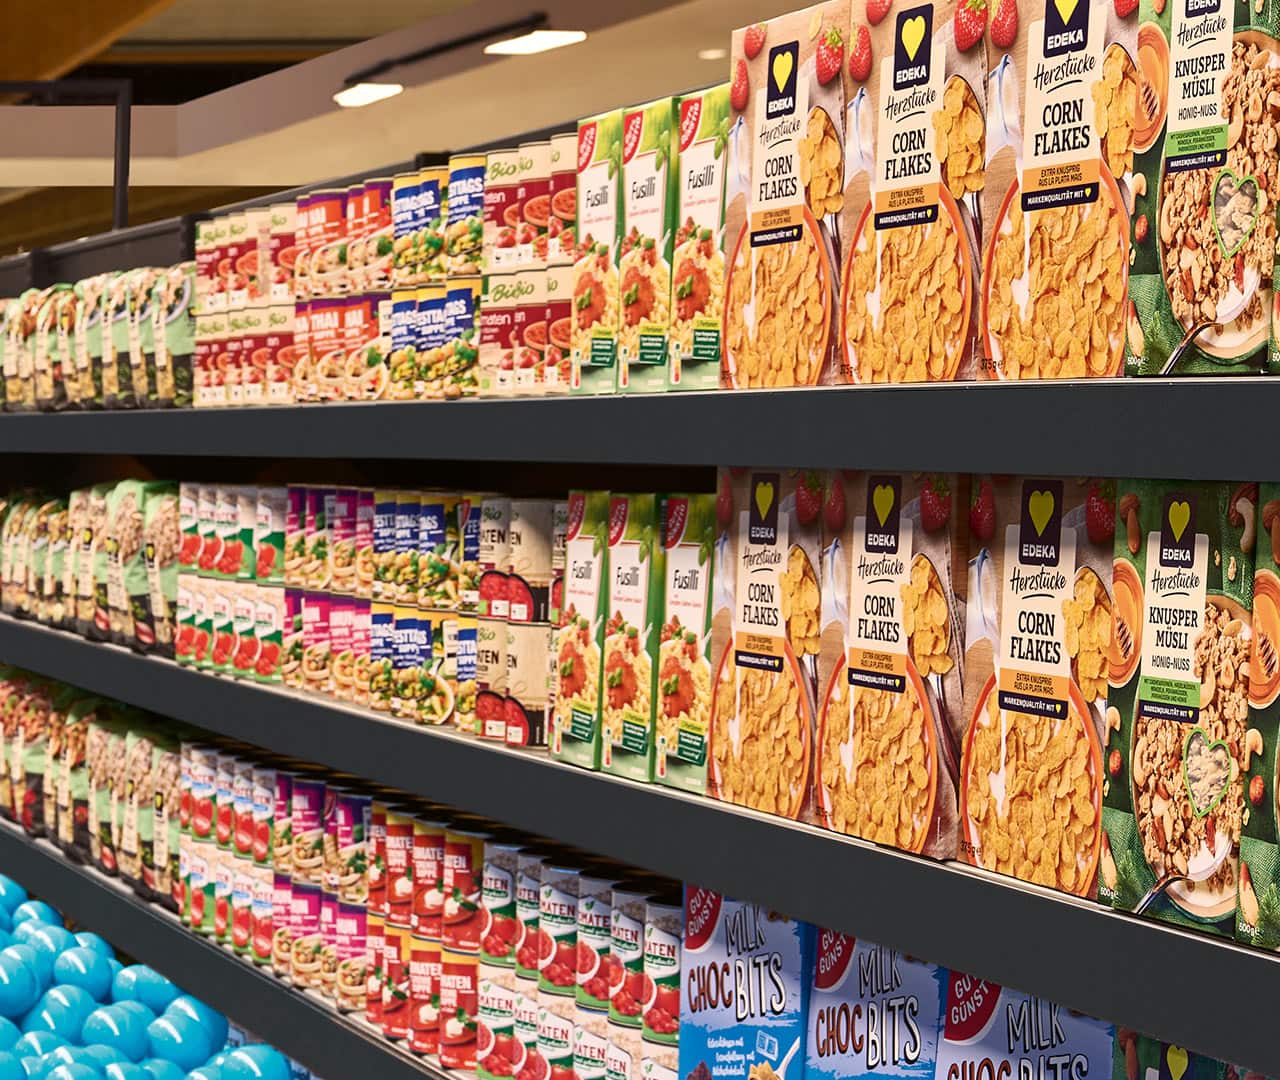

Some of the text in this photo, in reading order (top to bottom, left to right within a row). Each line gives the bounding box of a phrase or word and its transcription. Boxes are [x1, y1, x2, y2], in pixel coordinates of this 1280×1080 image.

[1047, 28, 1084, 50] EDEKA
[1177, 13, 1226, 46] Herzstücke
[896, 65, 926, 83] EDEKA
[1033, 53, 1096, 91] Herzstücke
[1175, 53, 1225, 78] KNUSPER
[1182, 76, 1215, 99] MÜSLI
[768, 97, 793, 113] EDEKA
[885, 86, 937, 120] Herzstücke
[1043, 99, 1084, 128] CORN
[1178, 103, 1217, 121] HONIG-NUSS
[760, 119, 800, 145] Herzstücke
[892, 128, 926, 154] CORN
[1034, 125, 1090, 156] FLAKES
[688, 165, 714, 190] Fusilli
[765, 155, 792, 178] CORN
[885, 152, 931, 180] FLAKES
[759, 177, 797, 201] FLAKES
[1074, 189, 1084, 198] MIT
[751, 526, 775, 539] EDEKA
[867, 534, 896, 548] EDEKA
[742, 544, 783, 567] Herzstücke
[1023, 544, 1056, 559] EDEKA
[1163, 549, 1191, 561] EDEKA
[857, 553, 904, 577] Herzstücke
[1010, 566, 1066, 594] Herzstücke
[1152, 566, 1200, 593] Herzstücke
[748, 583, 775, 603] CORN
[743, 604, 779, 627] FLAKES
[864, 595, 895, 618] CORN
[1149, 606, 1198, 627] KNUSPER
[857, 617, 900, 643] FLAKES
[1018, 611, 1055, 636] CORN
[1010, 636, 1061, 664] FLAKES
[1156, 627, 1188, 650] MÜSLI
[1152, 655, 1190, 671] HONIG-NUSS
[724, 904, 767, 957] MILK
[859, 946, 902, 998] MILK
[687, 951, 787, 1022] CHOC BITS
[816, 1002, 864, 1058] CHOC
[867, 996, 921, 1070] BITS
[1007, 994, 1066, 1054] MILK
